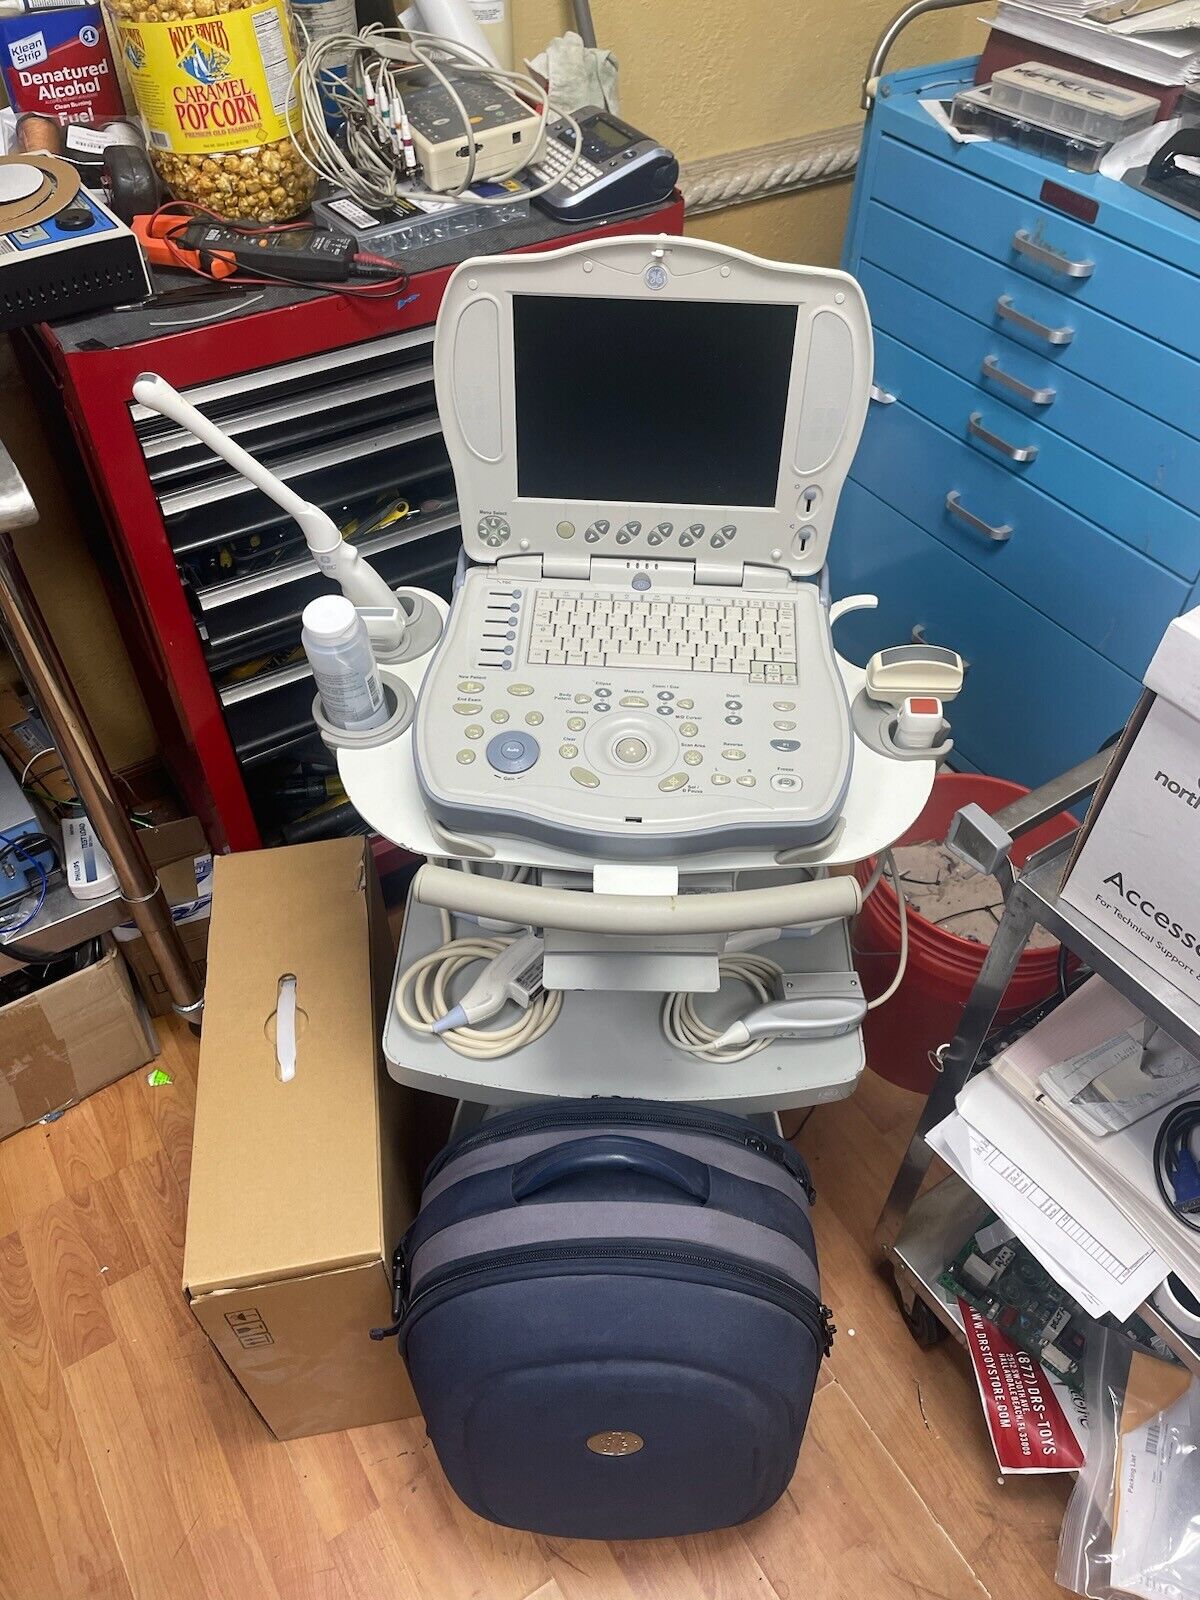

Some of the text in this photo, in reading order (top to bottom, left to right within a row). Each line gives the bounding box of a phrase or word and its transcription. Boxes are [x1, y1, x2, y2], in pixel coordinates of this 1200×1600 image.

[11, 40, 42, 56] Klean
[17, 49, 41, 64] Strip
[19, 59, 108, 87] Denatured
[39, 77, 101, 100] Alcohol
[173, 79, 251, 104] CARAMEL
[58, 107, 94, 126] Fuel
[174, 95, 262, 131] POPCORN
[73, 861, 81, 882] PHILIPS
[1095, 894, 1194, 976] For Technical Support
[1006, 1353, 1017, 1369] 2512
[998, 1353, 1017, 1395] HALLANDALE
[1017, 1422, 1025, 1431] FL
[1015, 1351, 1057, 1456] (877) DRS-TOYS
[1128, 1467, 1137, 1494] Packing
